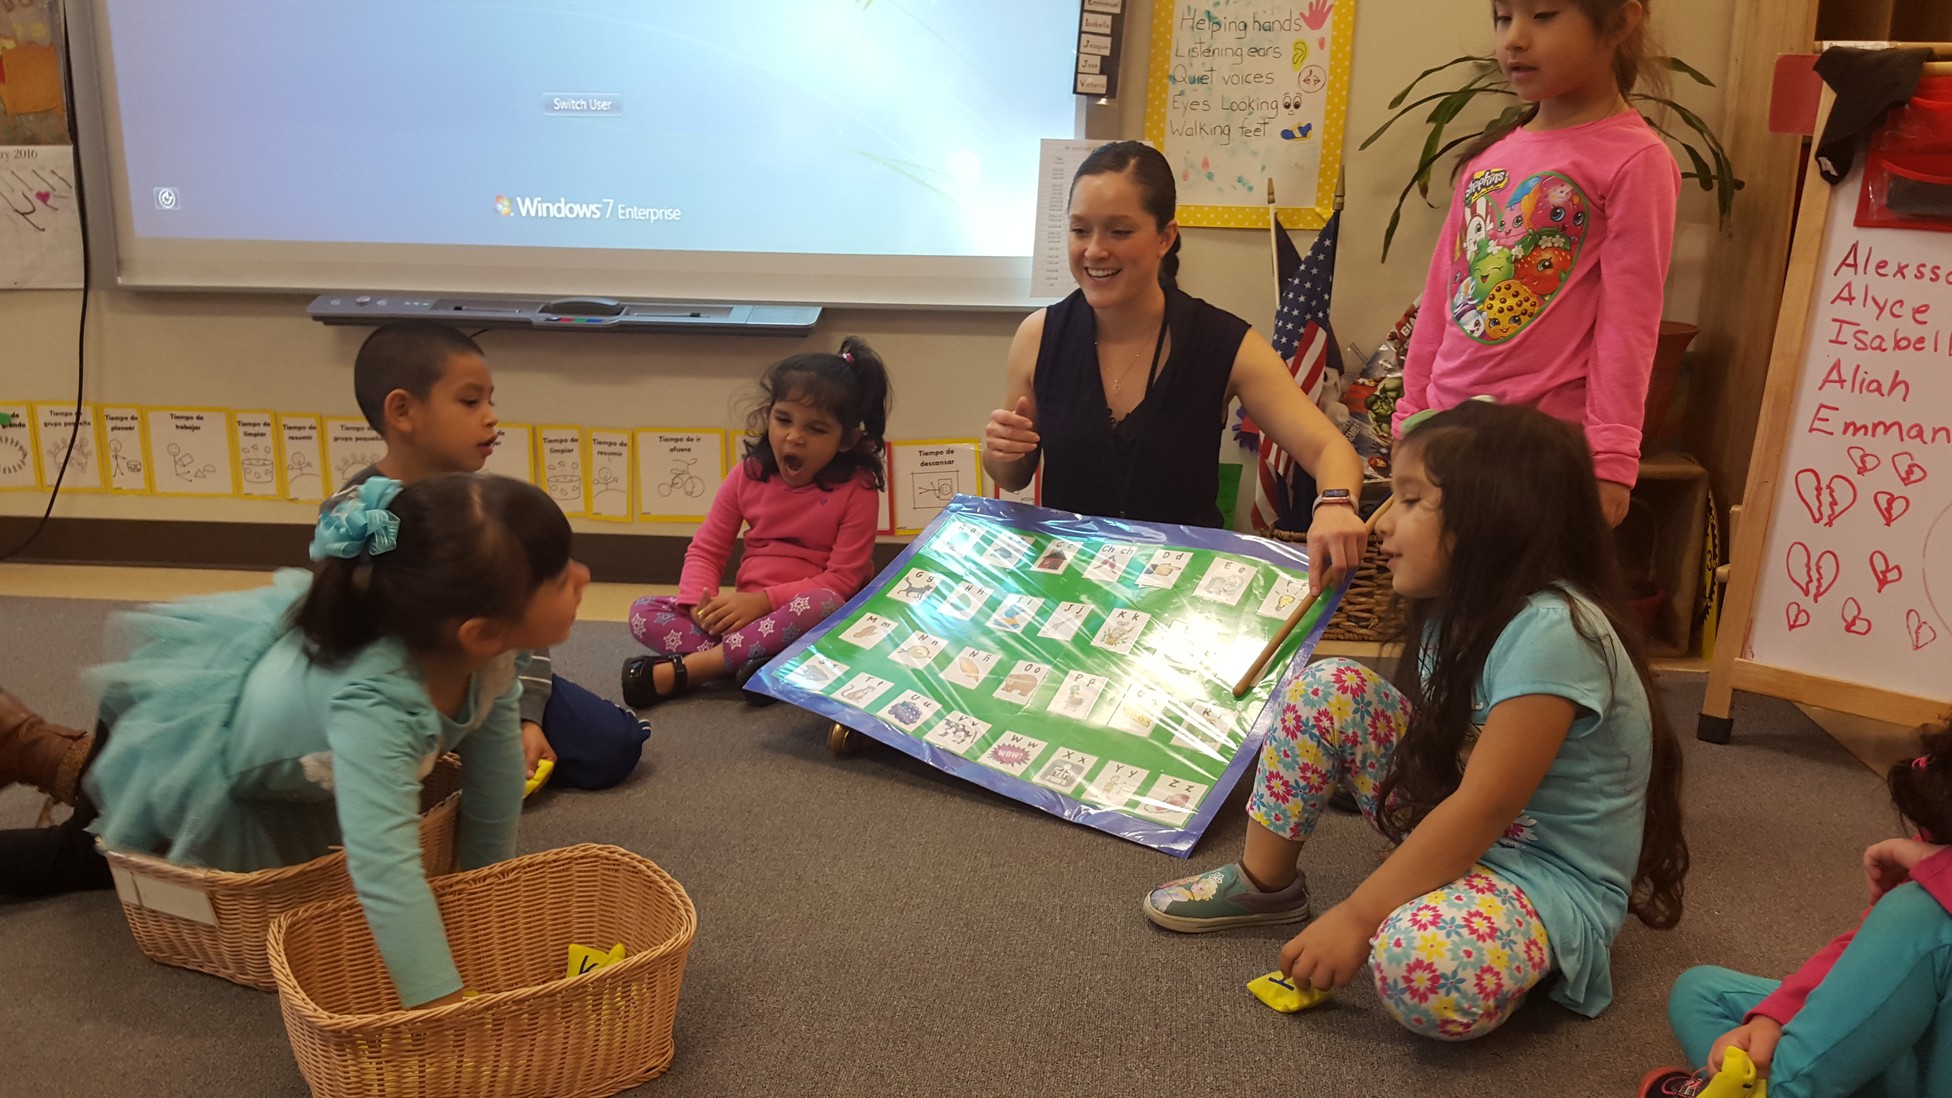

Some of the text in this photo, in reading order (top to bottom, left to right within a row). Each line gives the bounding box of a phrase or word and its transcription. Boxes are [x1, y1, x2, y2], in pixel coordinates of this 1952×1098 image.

[1180, 8, 1302, 40] Helping hands
[1175, 37, 1282, 66] Listening ears
[1173, 64, 1275, 86] Quiet voices
[553, 97, 613, 111] Switch User
[1172, 94, 1279, 120] Eyes Looking
[1169, 117, 1269, 146] Walking feet
[13, 148, 38, 160] 2016
[516, 196, 683, 224] Windows 7 Enterprise
[1830, 281, 1931, 326] Alyce
[1400, 310, 1419, 337] GIA
[1828, 317, 1952, 357] Isabell
[1817, 358, 1911, 403] Aliah
[105, 414, 128, 422] Tiempo
[170, 413, 194, 421] Tiempo
[237, 420, 260, 428] Tiempo
[340, 424, 365, 432] Tiempo
[1808, 402, 1952, 445] Emman
[592, 438, 617, 447] Tiempo
[658, 435, 683, 443] Tiempo
[918, 449, 944, 457] Tiempo
[919, 459, 955, 467] descansar
[1101, 545, 1134, 555] Ch ch
[1162, 551, 1185, 560] D d
[1223, 561, 1233, 570] E
[964, 584, 974, 592] H
[1063, 604, 1085, 614] J j
[866, 615, 878, 623] M
[1117, 610, 1140, 621] K k
[1024, 663, 1033, 672] O
[1074, 673, 1096, 687] P p
[1010, 734, 1024, 743] W
[1062, 750, 1088, 765] X x
[1115, 764, 1138, 779] Y y
[1168, 779, 1196, 793] Z z
